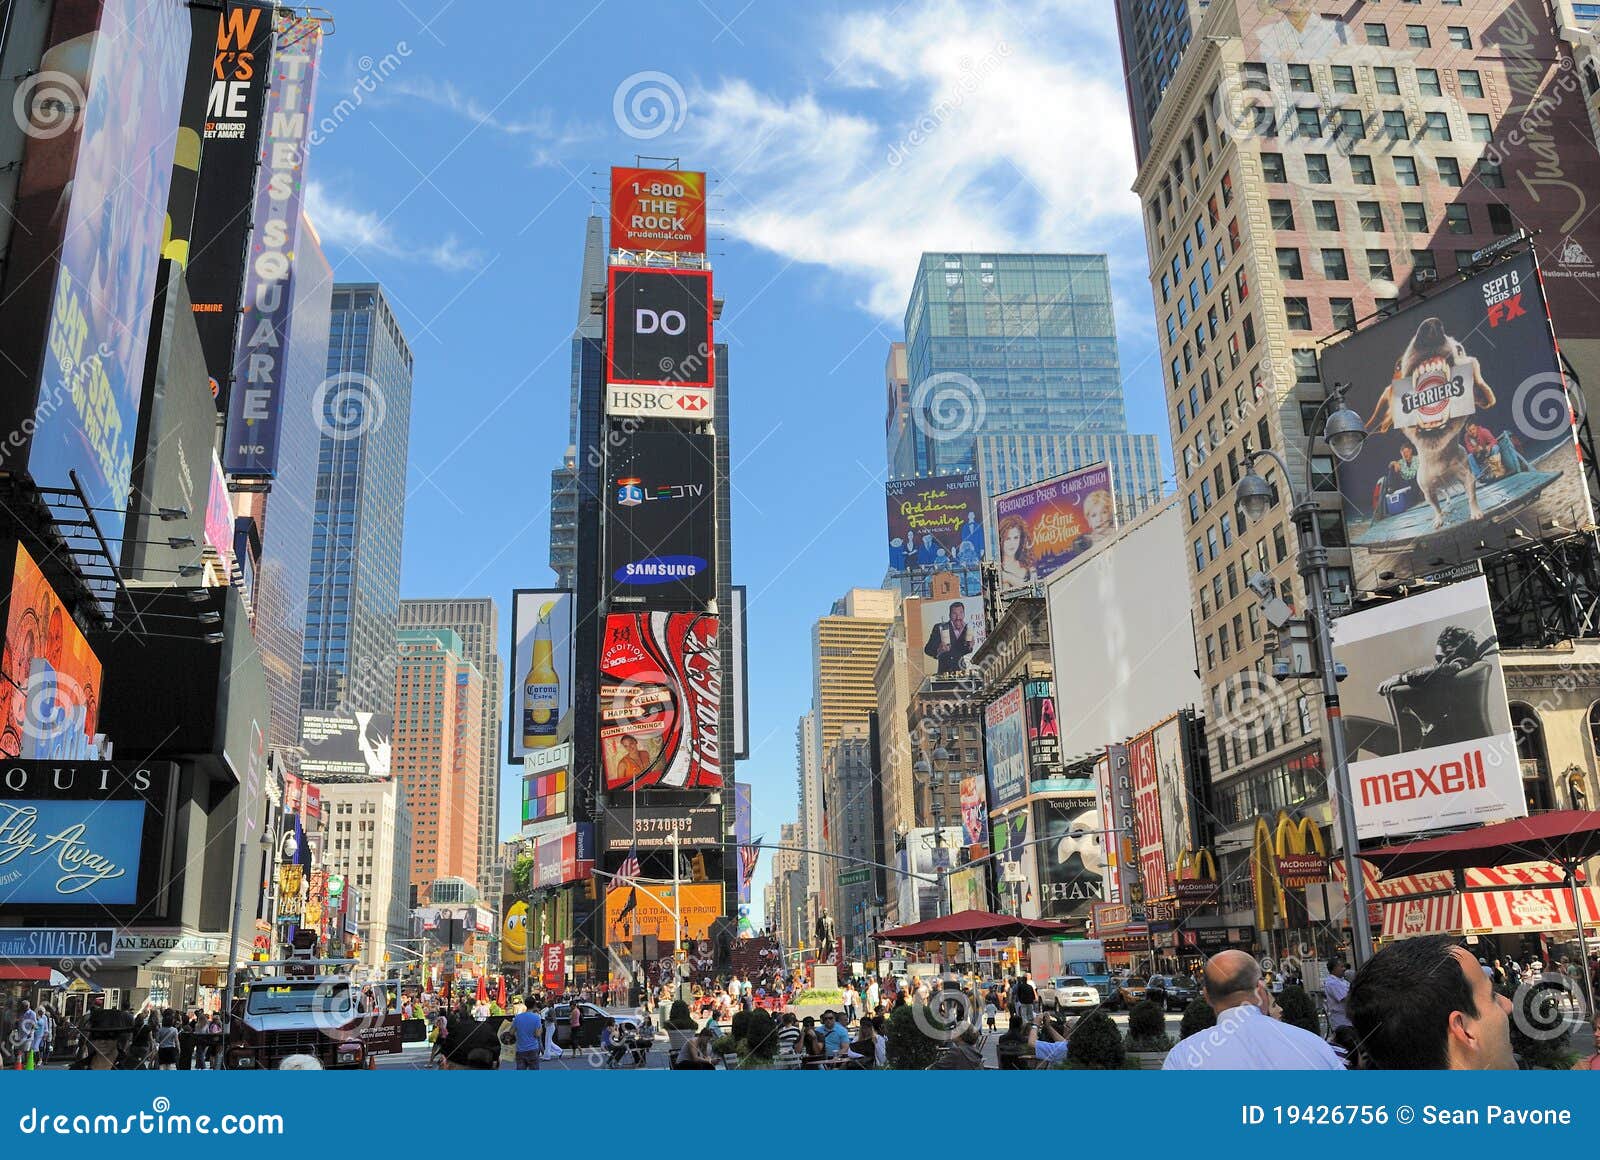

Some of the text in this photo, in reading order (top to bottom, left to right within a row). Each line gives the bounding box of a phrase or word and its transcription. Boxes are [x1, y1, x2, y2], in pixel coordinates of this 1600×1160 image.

[632, 182, 684, 198] 1-800
[639, 199, 678, 214] THE
[631, 215, 686, 232] ROCK
[243, 55, 310, 419] TIMES SQUARE
[627, 231, 692, 241] prudential.com
[1482, 270, 1520, 298] SEPT 8
[1485, 285, 1521, 307] WEDS 10
[55, 265, 89, 368] SAT
[1487, 293, 1527, 328] FX
[636, 309, 686, 336] DO
[612, 391, 674, 411] HSBC
[1405, 379, 1461, 410] TERRIERS
[238, 444, 265, 456] NYC
[644, 485, 684, 500] LED
[684, 484, 703, 497] TV
[886, 481, 916, 489] NATHAN
[886, 488, 904, 496] LANE
[918, 490, 948, 501] The
[1000, 494, 1035, 513] BERNADETTE
[1036, 486, 1057, 504] PETERS
[901, 500, 967, 515] Addams
[908, 513, 964, 531] Family
[626, 563, 696, 576] SAMSUNG
[602, 643, 645, 668] EXPEDITION
[1508, 674, 1544, 688] SHOW
[527, 685, 557, 696] Corona
[635, 694, 660, 704] KELLY
[684, 630, 722, 776] Coca-Cola
[987, 702, 999, 717] THE
[999, 688, 1020, 708] CROWD
[5, 768, 151, 791] QUIS
[1360, 750, 1487, 806] maxell
[1049, 800, 1077, 809] Tonight
[0, 803, 125, 894] Fly Away
[638, 838, 663, 846] OWNERS
[683, 837, 692, 845] BE
[1280, 860, 1328, 868] McDonald's
[1041, 881, 1103, 901] PHAN
[694, 906, 717, 914] PROUD
[29, 931, 98, 956] SINATRA
[115, 938, 136, 949] AN
[141, 938, 180, 949] EAGLE
[548, 945, 560, 972] tkts
